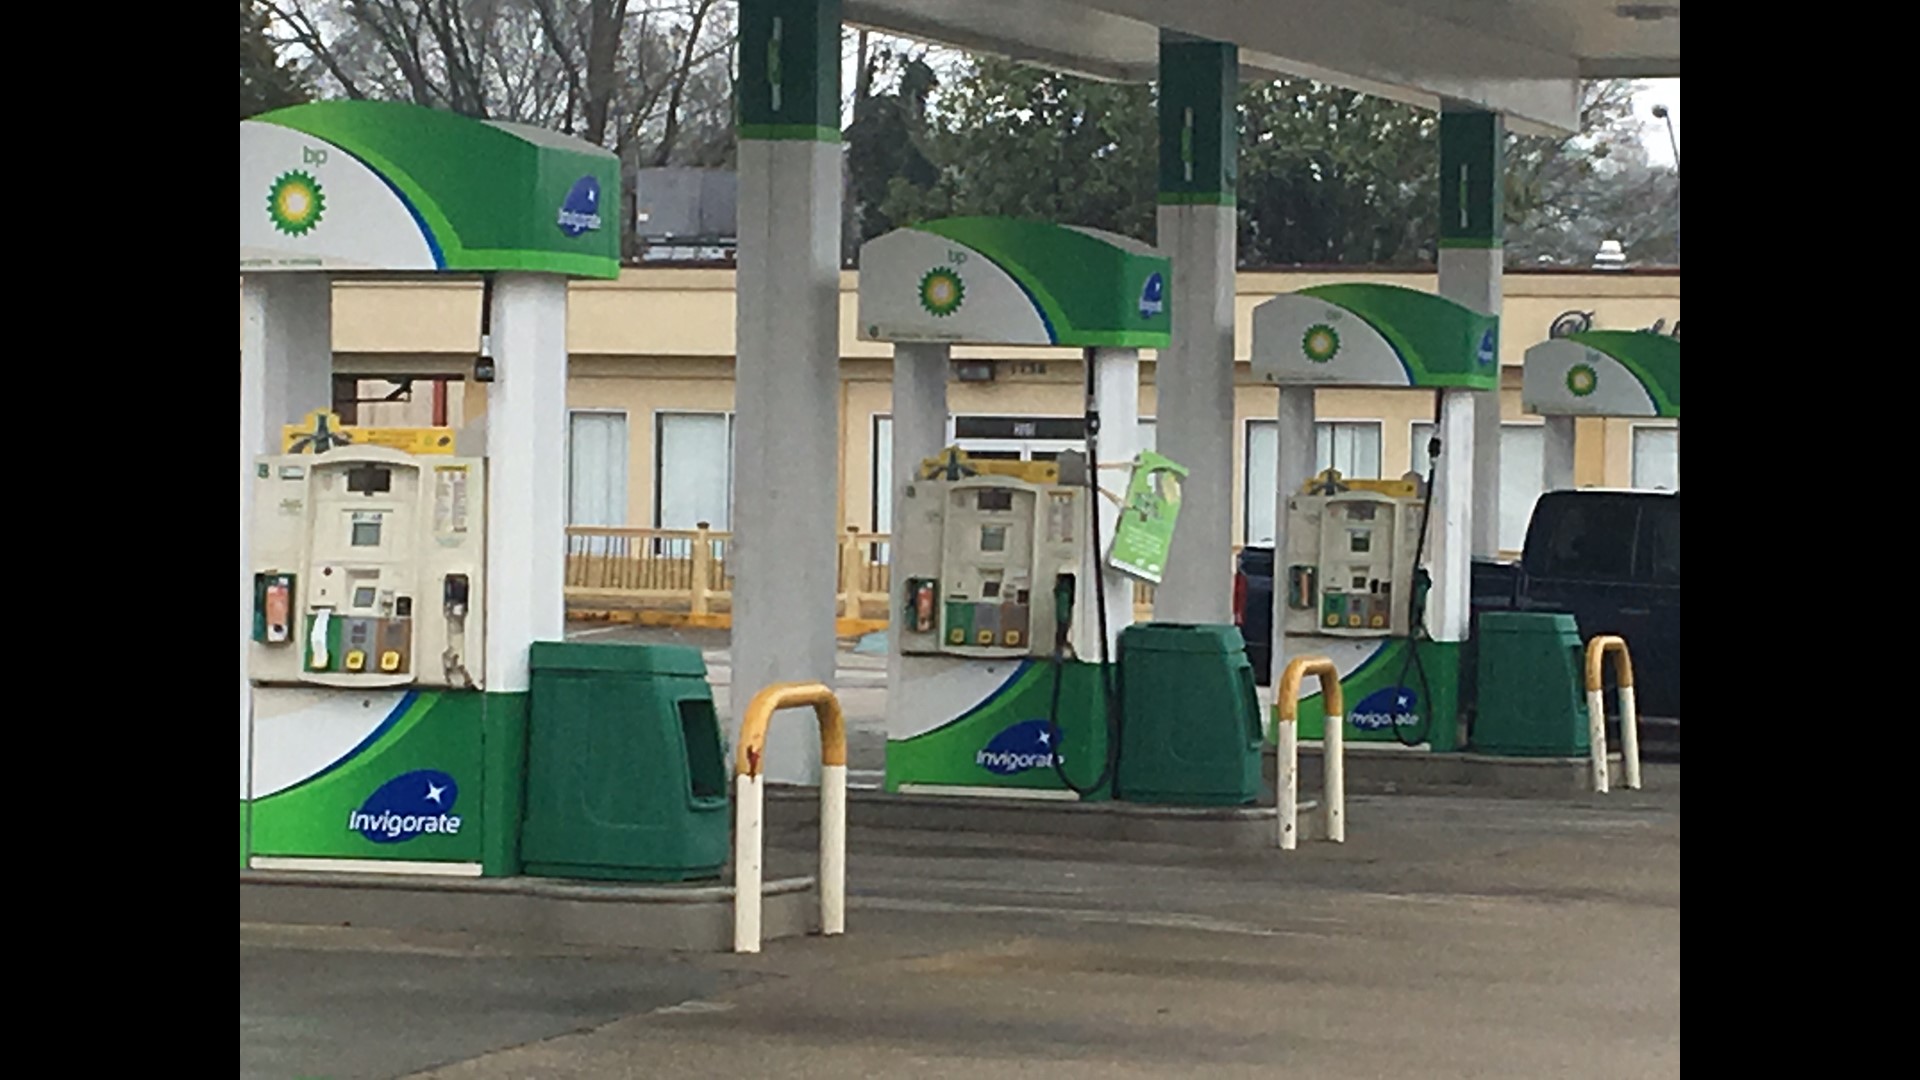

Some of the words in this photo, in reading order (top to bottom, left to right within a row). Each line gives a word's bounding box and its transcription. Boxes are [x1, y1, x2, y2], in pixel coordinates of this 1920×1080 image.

[303, 146, 328, 165] bp
[1347, 710, 1420, 728] Invigoate
[349, 810, 462, 837] Invigorate
